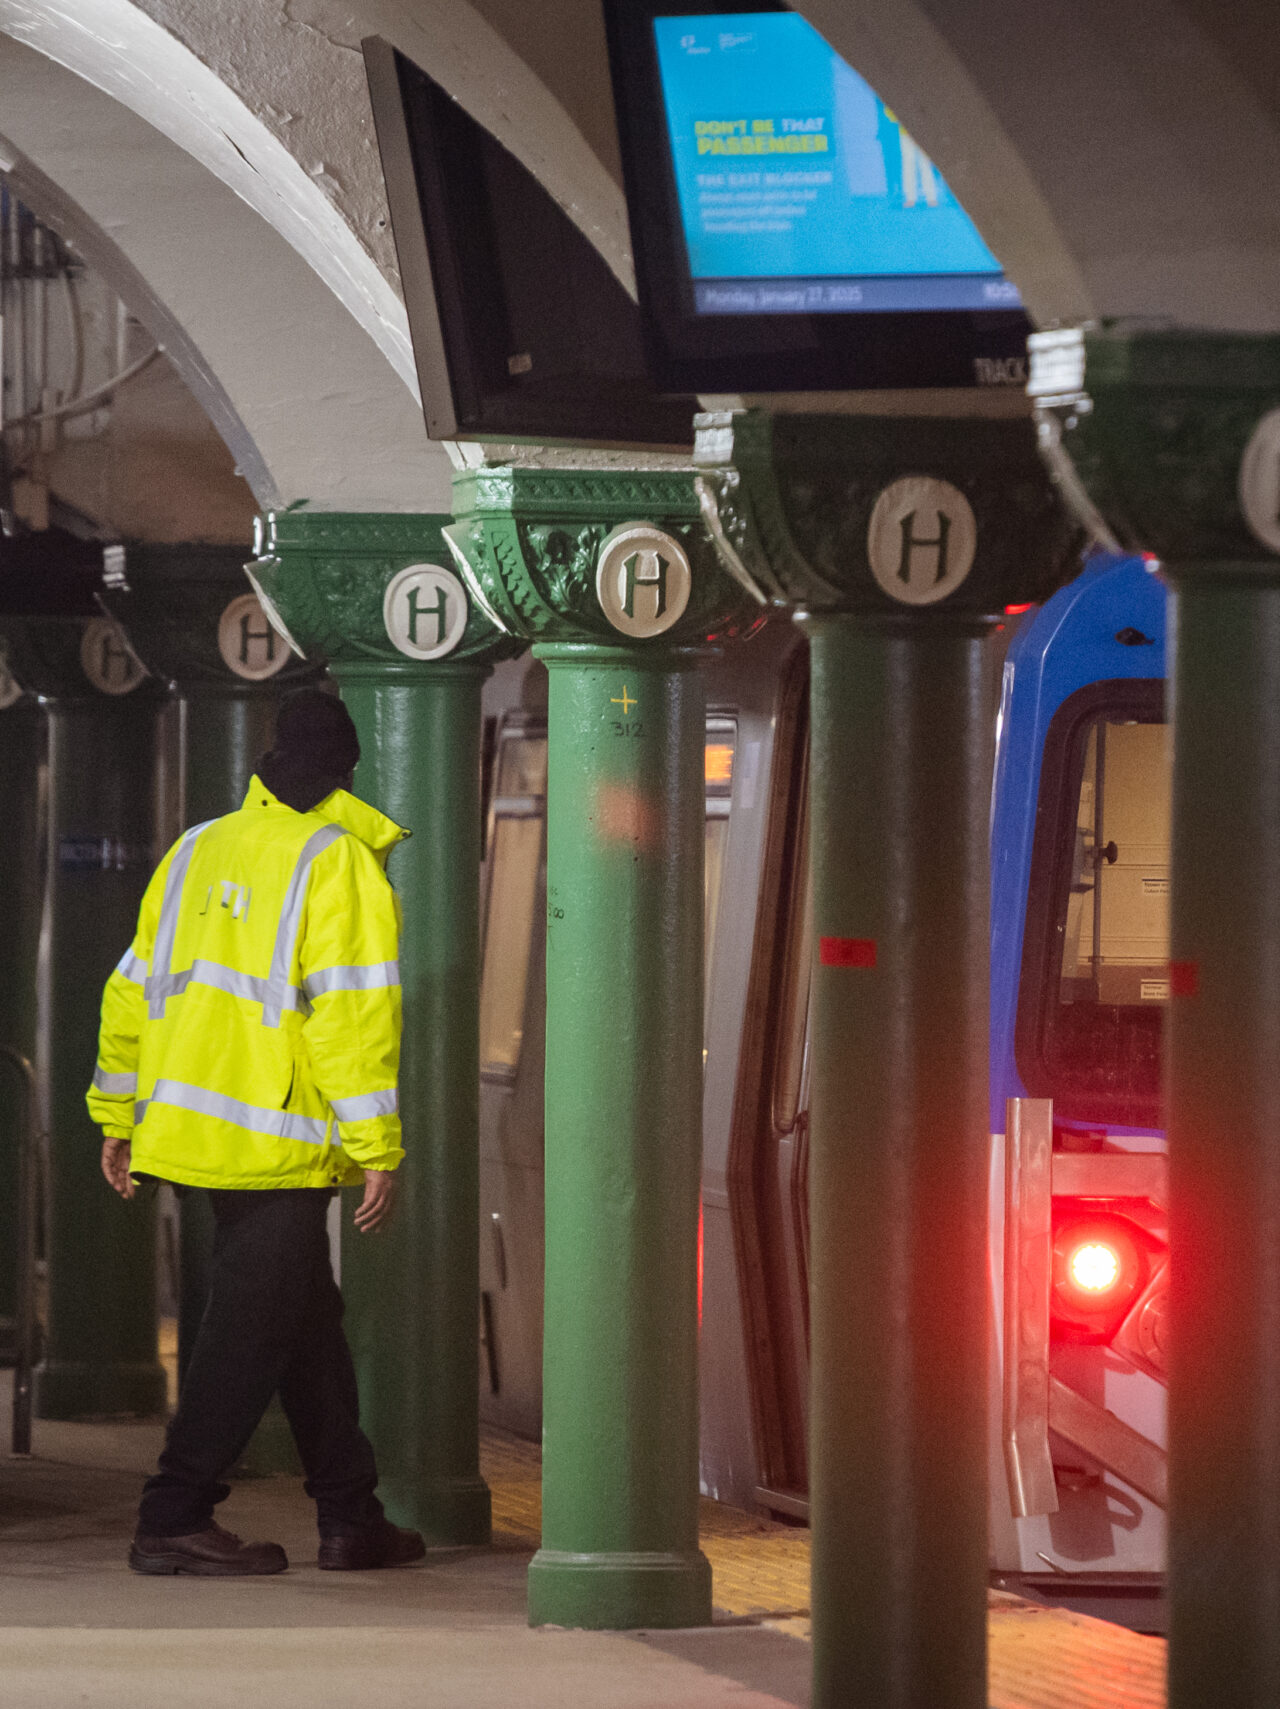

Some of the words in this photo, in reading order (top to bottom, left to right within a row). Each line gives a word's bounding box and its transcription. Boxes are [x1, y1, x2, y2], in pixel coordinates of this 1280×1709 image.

[694, 120, 747, 135] DON'T
[752, 119, 774, 134] BE
[781, 117, 825, 132] THAT
[697, 134, 829, 155] PASSENGER
[897, 510, 951, 583] H
[622, 551, 670, 619] H
[239, 613, 274, 665] H
[407, 585, 448, 645] H
[610, 721, 645, 738] 312
